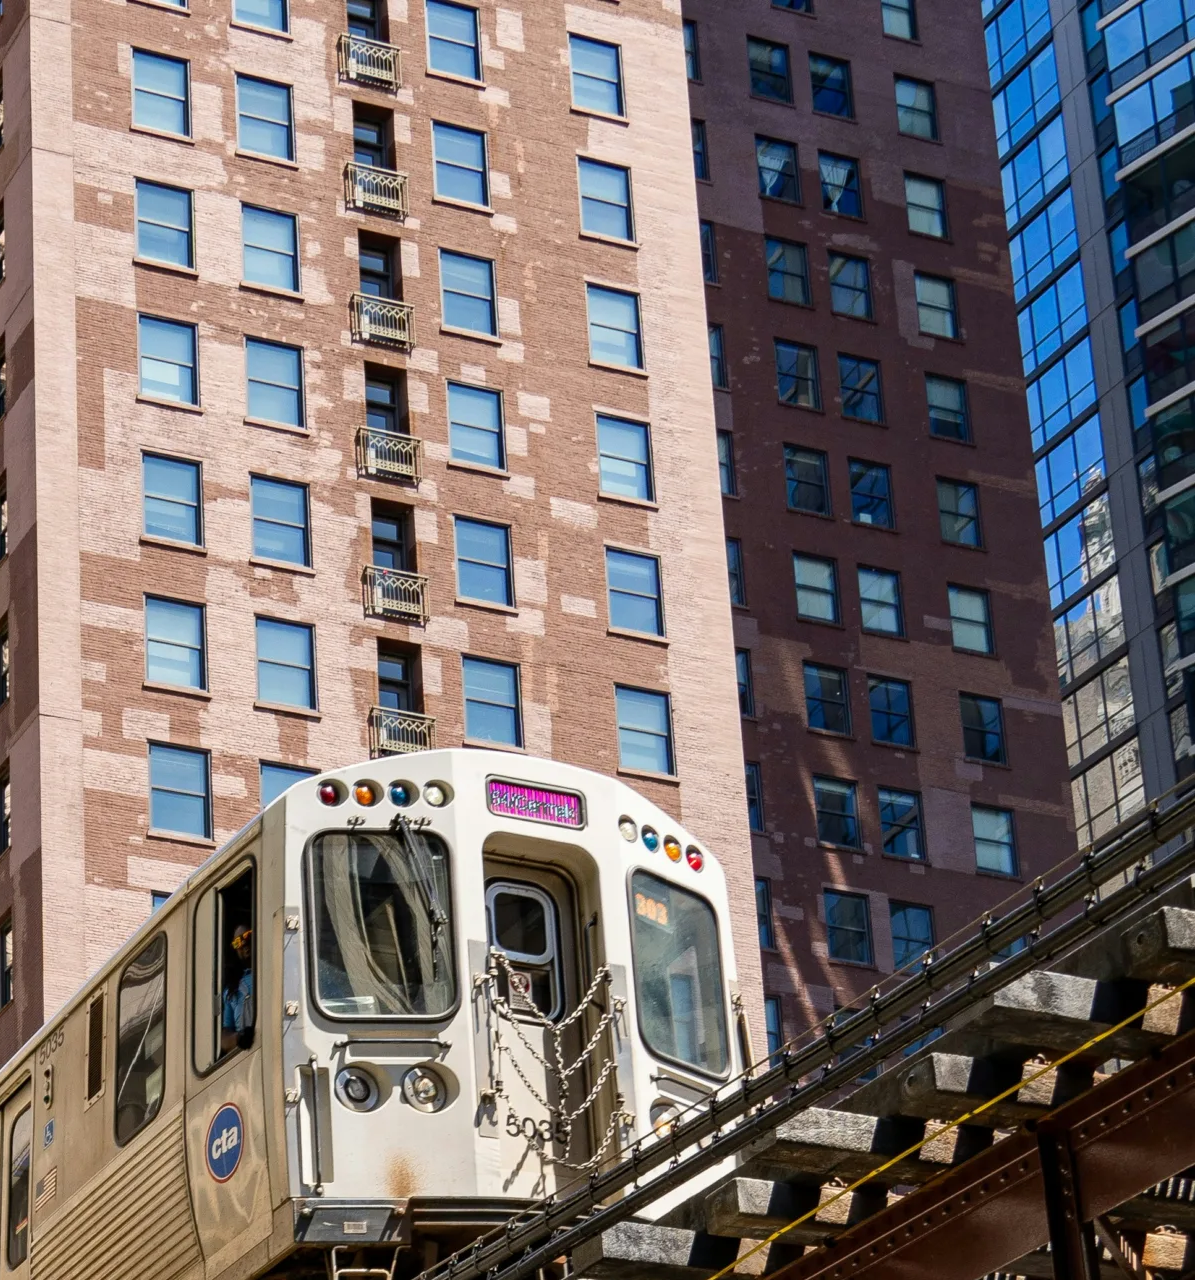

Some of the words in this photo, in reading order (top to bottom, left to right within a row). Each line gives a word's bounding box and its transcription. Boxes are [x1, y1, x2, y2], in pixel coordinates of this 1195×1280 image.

[39, 1025, 64, 1065] 5035
[211, 1126, 238, 1160] cta
[506, 1114, 570, 1144] 5035
